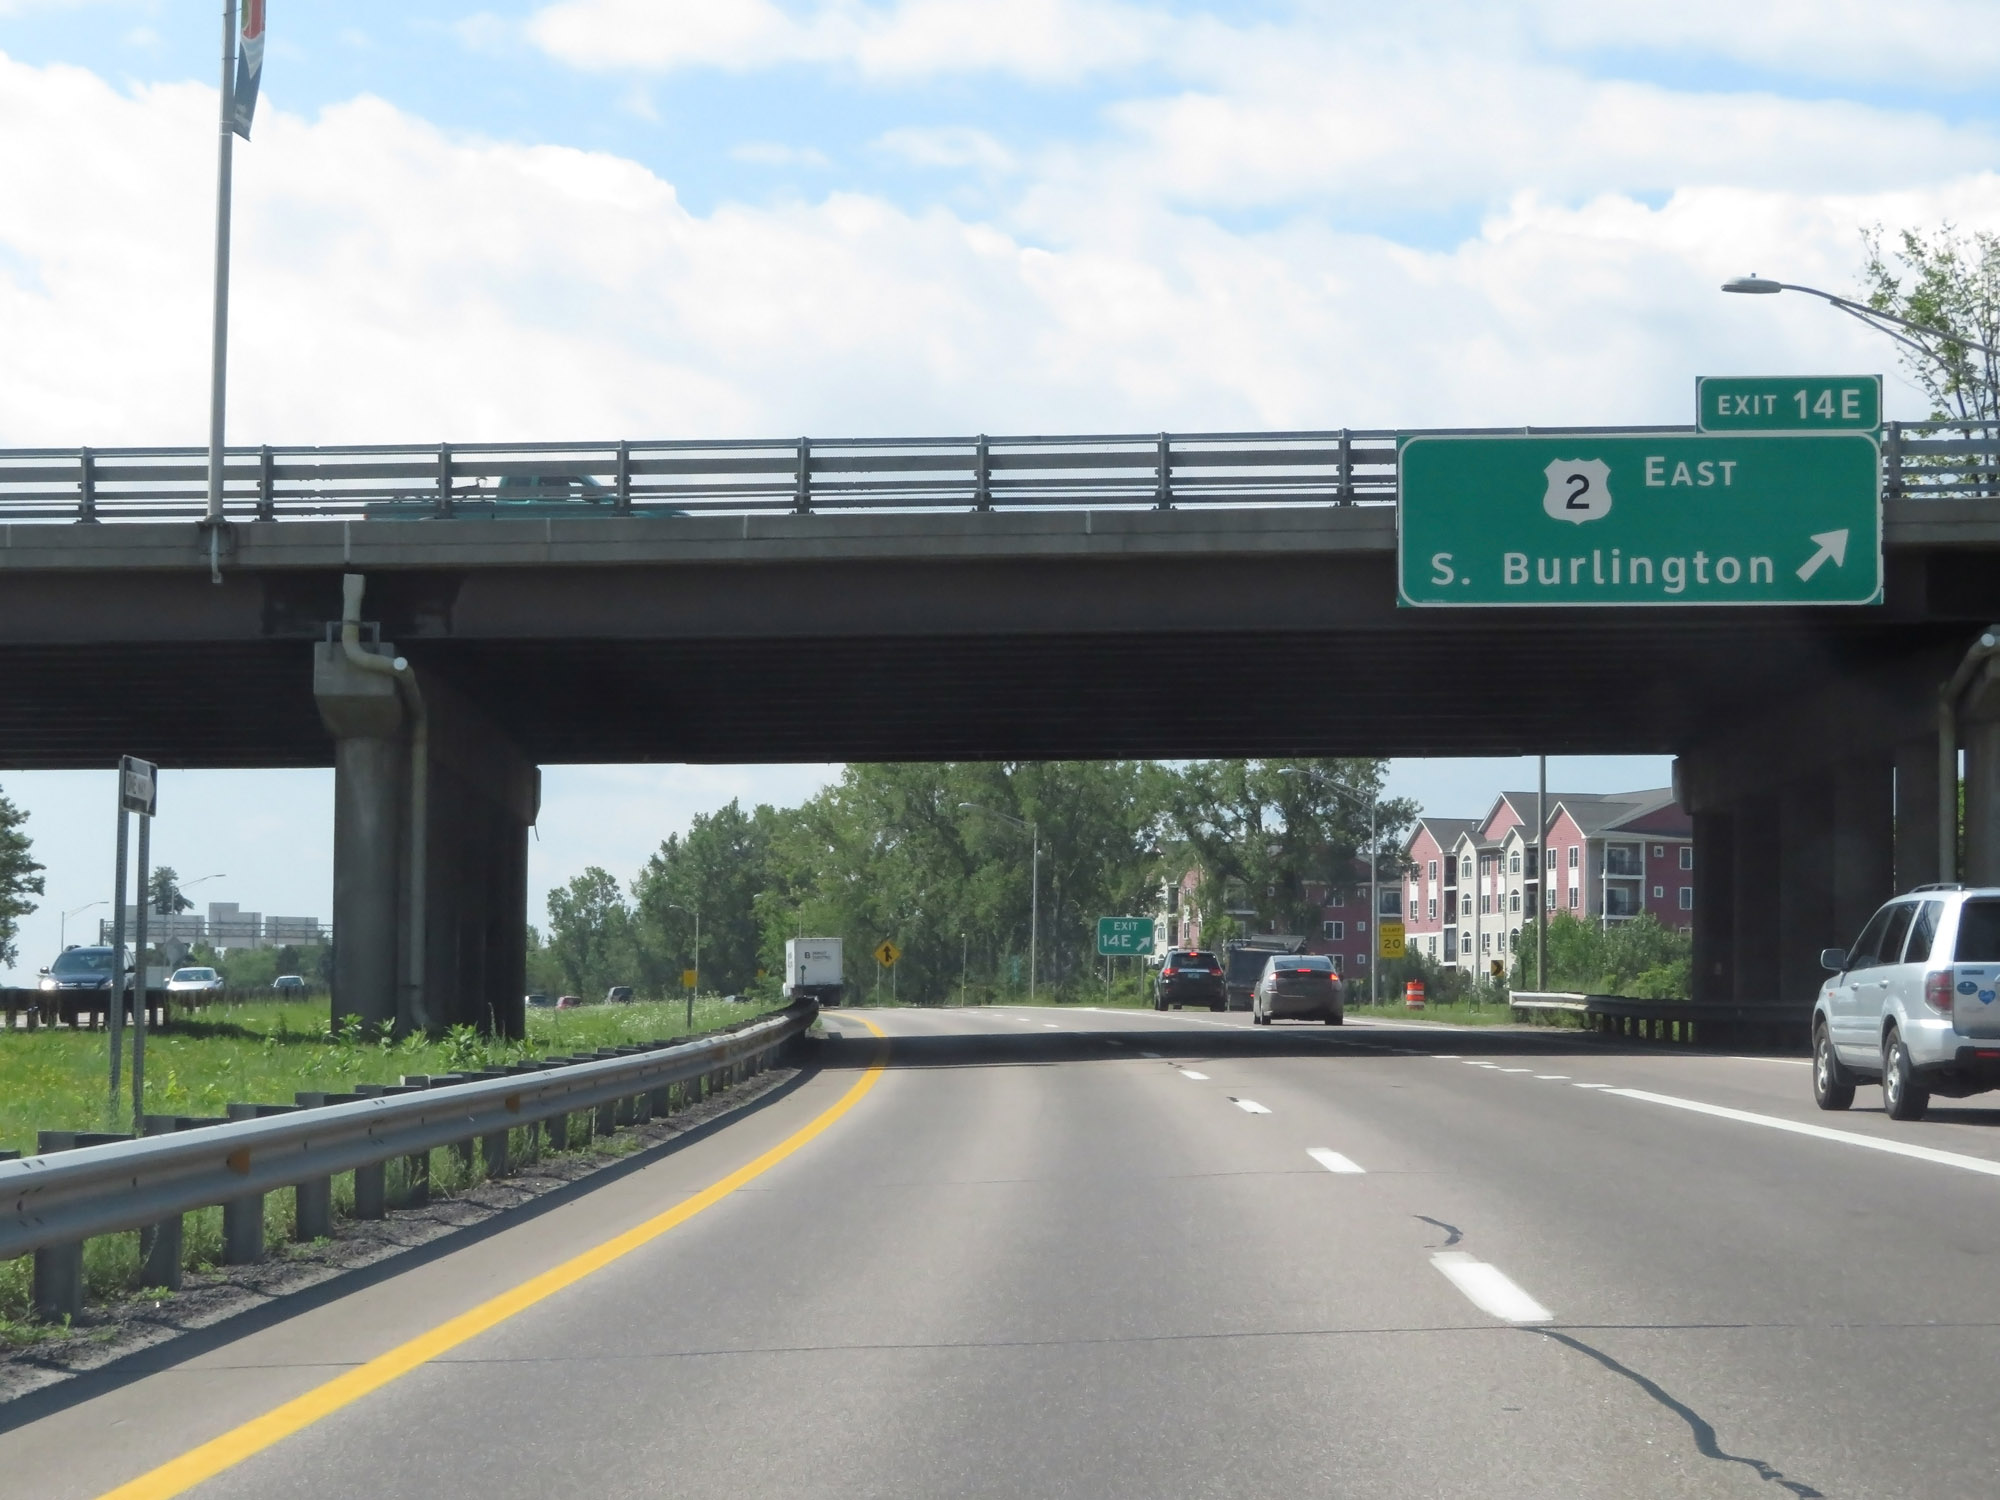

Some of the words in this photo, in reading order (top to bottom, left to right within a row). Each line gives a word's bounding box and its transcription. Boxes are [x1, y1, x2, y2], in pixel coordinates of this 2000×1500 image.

[1718, 395, 1777, 415] EXIT
[1793, 389, 1861, 419] 14E
[1566, 474, 1589, 509] 2
[1645, 456, 1736, 487] EAST
[1431, 552, 1471, 585] S.
[1503, 549, 1774, 593] Burlington
[1114, 922, 1138, 931] EXIT
[1103, 935, 1131, 947] 14E
[1384, 939, 1401, 949] 20
